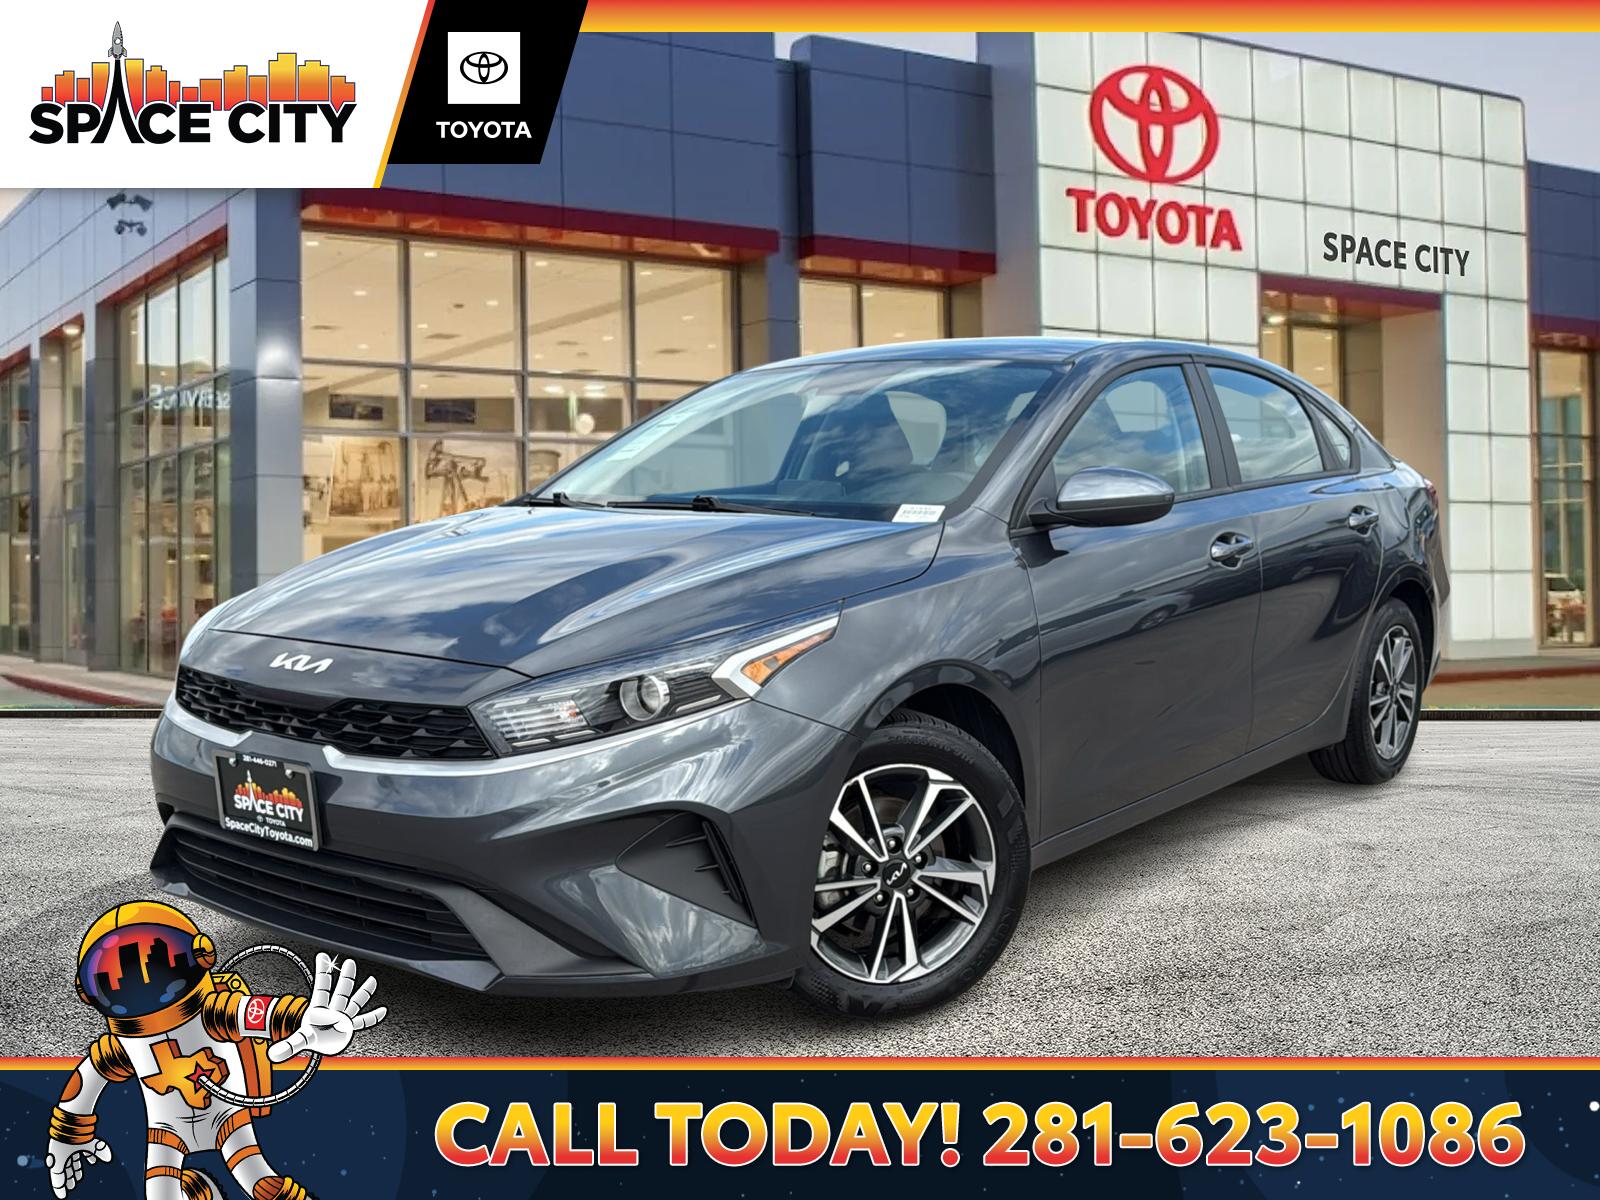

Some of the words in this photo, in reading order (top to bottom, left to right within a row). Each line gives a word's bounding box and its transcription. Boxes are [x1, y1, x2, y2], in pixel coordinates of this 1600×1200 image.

[1065, 187, 1243, 252] TOYOTA
[1323, 231, 1407, 270] SPACE
[1414, 243, 1470, 277] CITY
[233, 784, 275, 816] SPACE
[275, 803, 304, 822] CITY
[265, 817, 287, 827] TOYOTA
[225, 817, 313, 847] SpaceCityToyota.com
